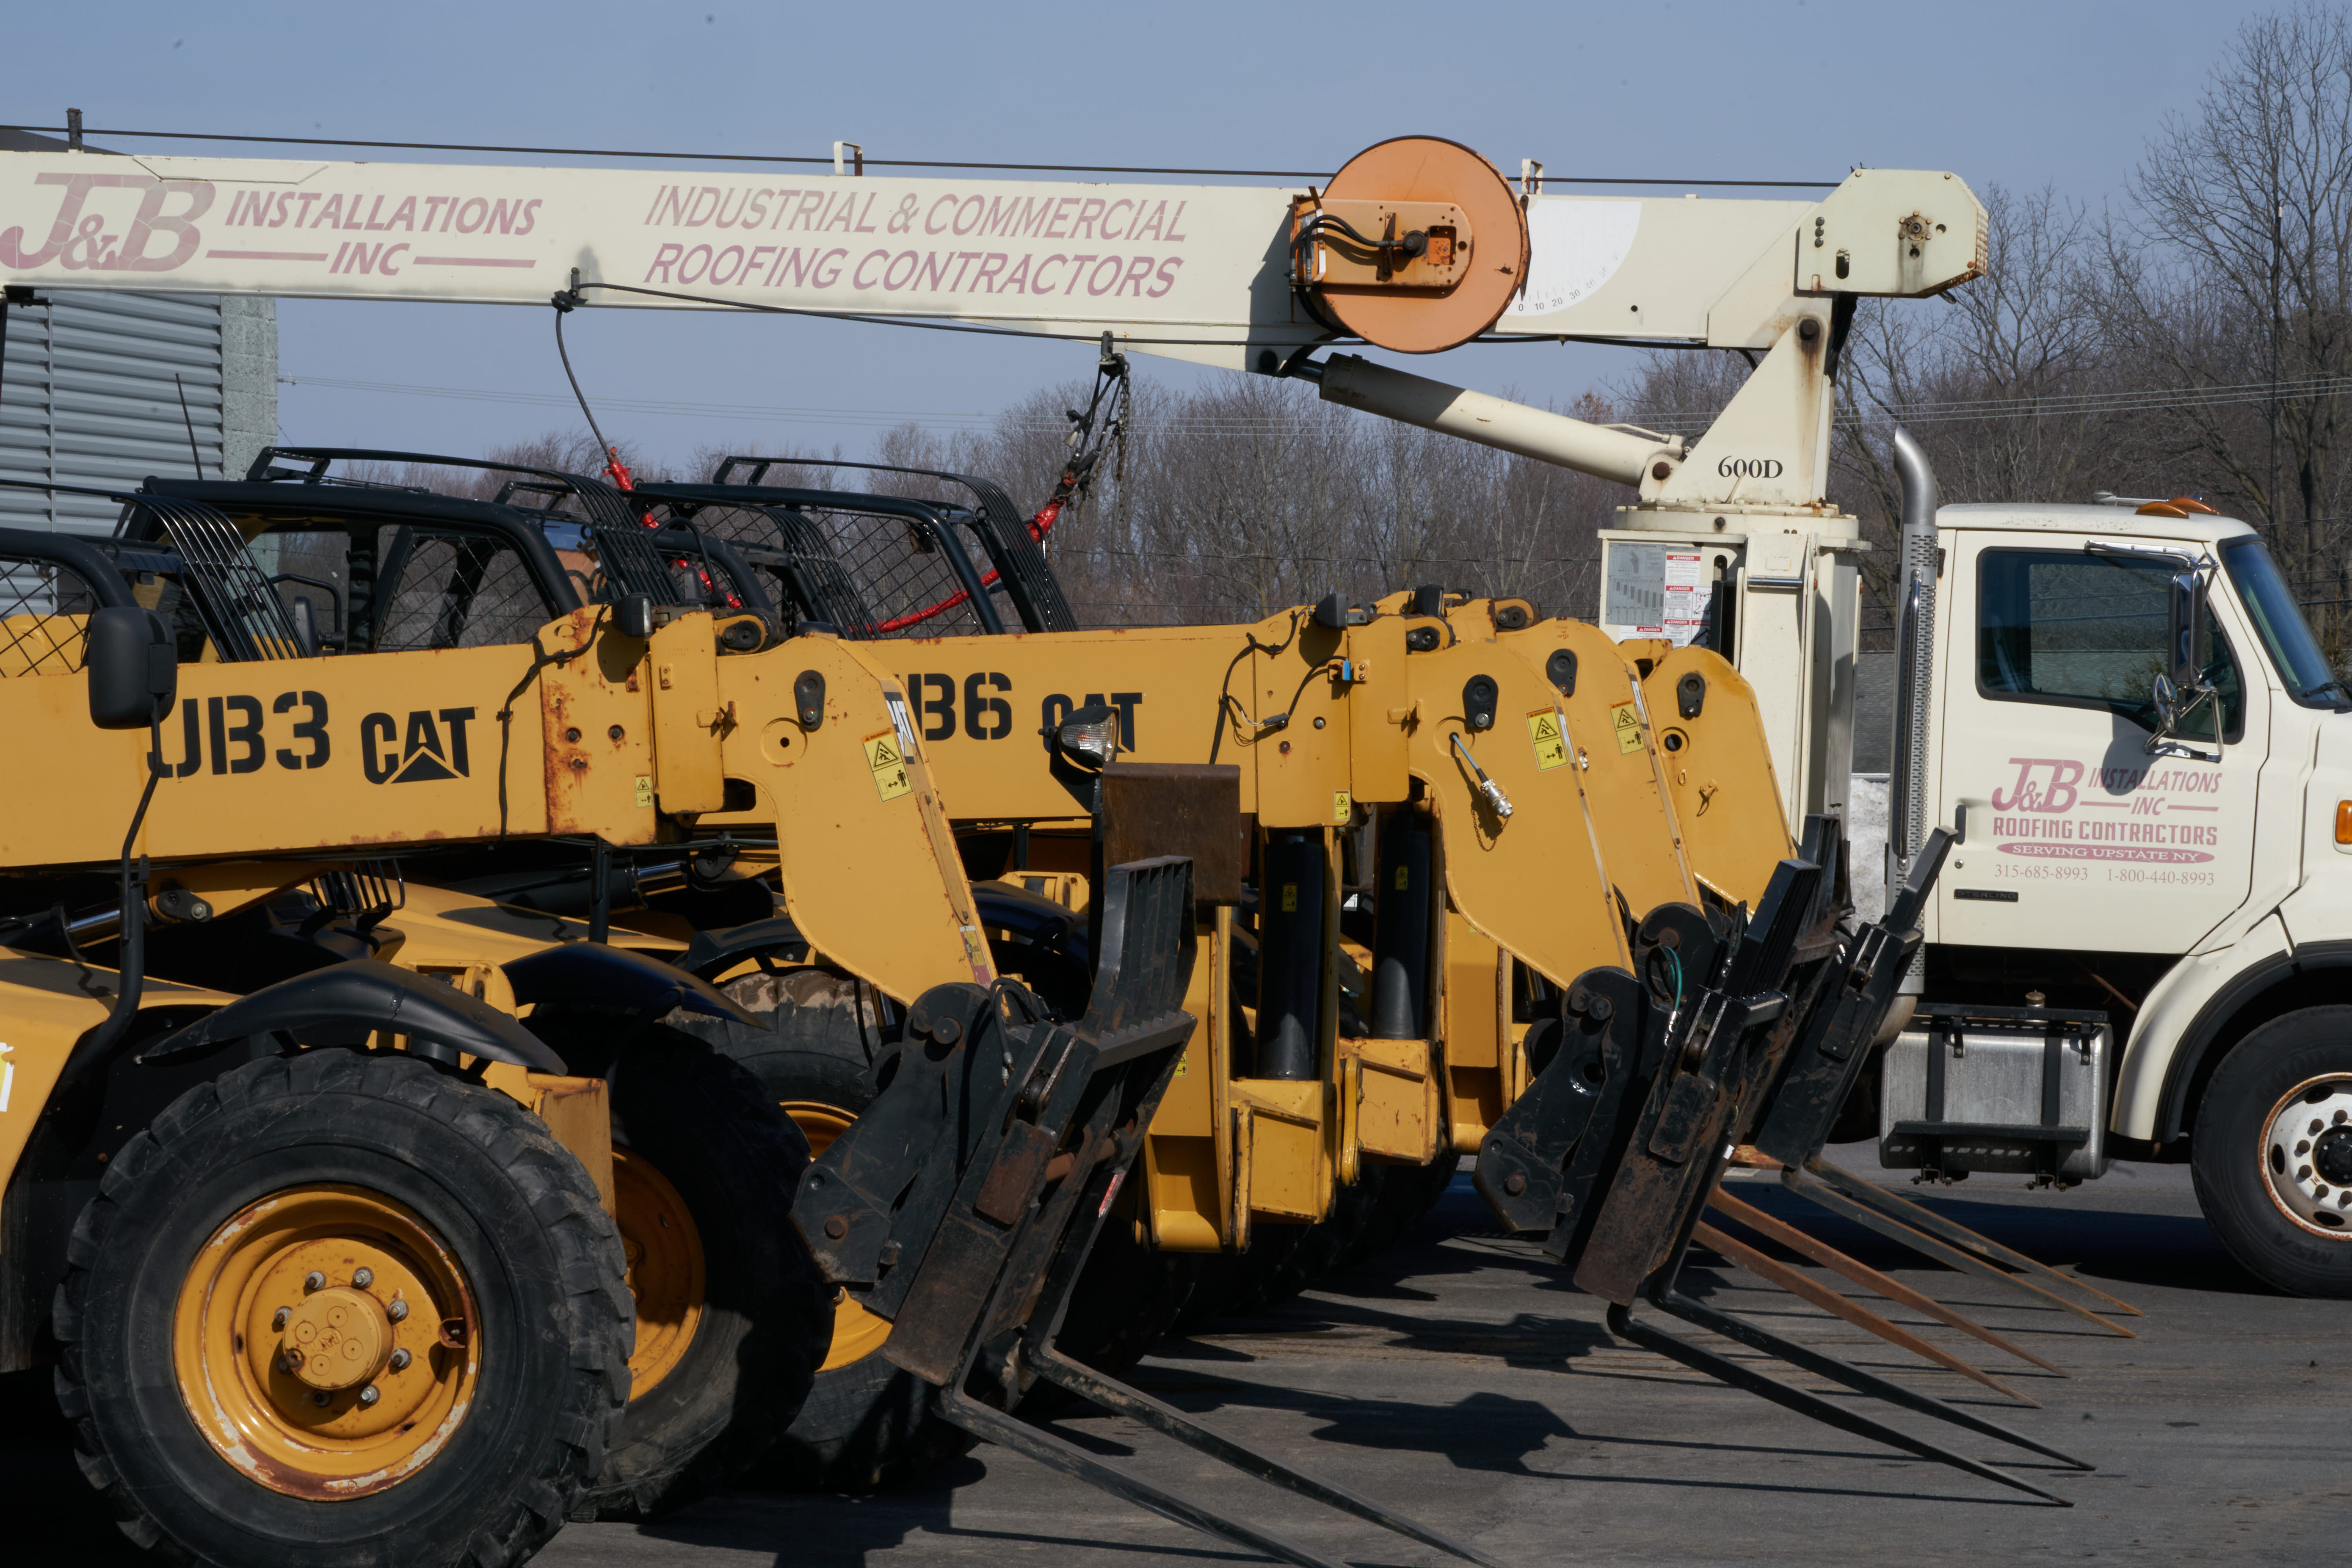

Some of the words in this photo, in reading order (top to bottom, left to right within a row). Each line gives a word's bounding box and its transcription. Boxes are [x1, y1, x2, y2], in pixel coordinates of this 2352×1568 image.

[0, 172, 216, 272] J&B
[225, 190, 542, 235] INSTALLATIONS
[644, 185, 877, 234] INDUSTRIAL
[887, 193, 920, 235] &
[925, 194, 1188, 243] COMMERCIAL
[329, 242, 410, 276] INC
[643, 243, 850, 289] ROOFING
[853, 249, 1184, 298] CONTRACTORS
[1534, 302, 1544, 310] 10
[1552, 297, 1563, 307] 20
[1569, 289, 1581, 299] 30
[1586, 279, 1596, 289] 40
[1718, 455, 1783, 479] 600D
[895, 672, 1012, 741] B6
[360, 706, 475, 785] CAT
[869, 730, 891, 739] WARNING
[1991, 758, 2084, 813] J&B
[2088, 768, 2223, 794] INSTALLATIONS
[2131, 797, 2166, 816] INC
[1993, 817, 2073, 839] ROOFING
[2079, 821, 2218, 846] CONTRACTORS
[2013, 845, 2088, 856] SERVING
[2091, 848, 2168, 860] UPSTATE
[2172, 852, 2199, 862] NY
[1994, 864, 2088, 881] 315-685-8993
[2107, 868, 2214, 886] 1-800-440-8993
[1957, 890, 2017, 900] STERLING
